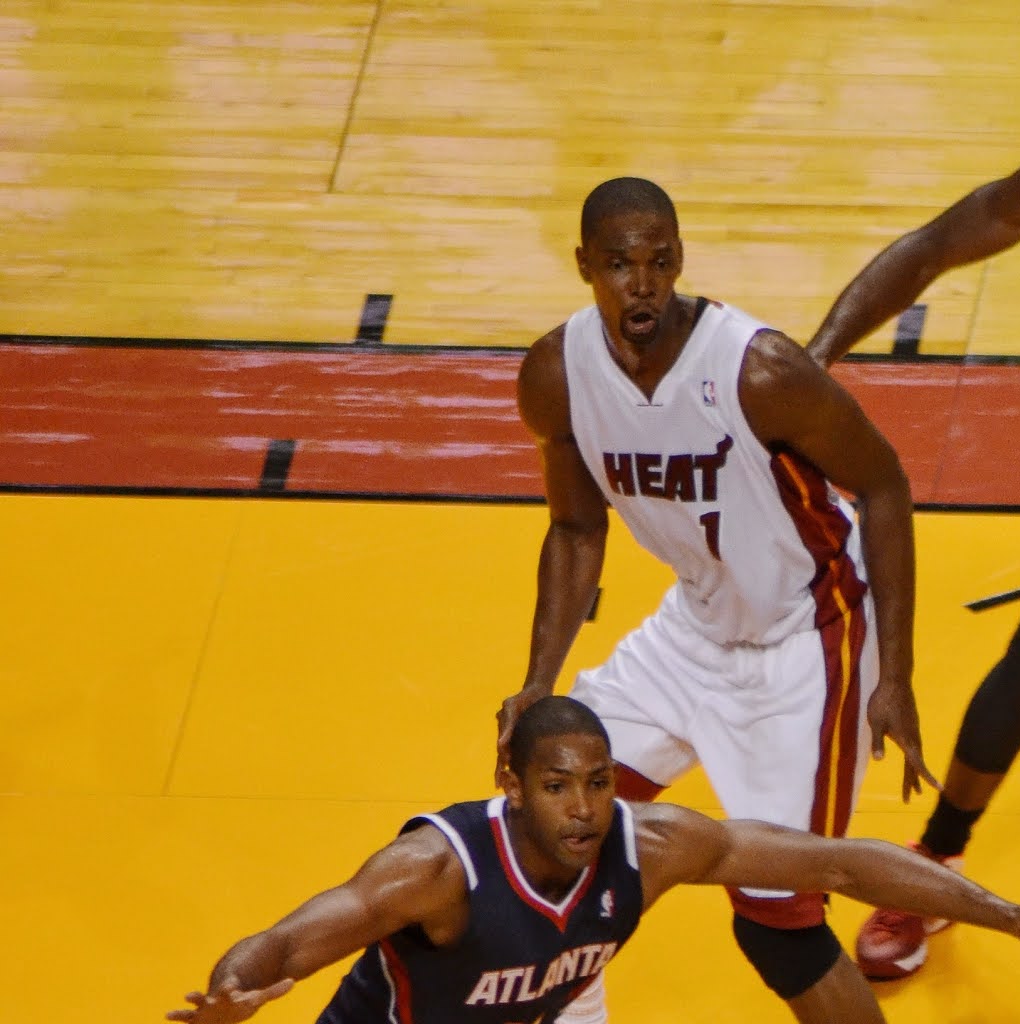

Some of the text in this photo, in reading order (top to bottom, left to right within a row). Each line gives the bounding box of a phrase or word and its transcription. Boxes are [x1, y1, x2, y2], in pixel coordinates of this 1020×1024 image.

[602, 433, 734, 503] HEAT
[699, 510, 722, 562] 1
[464, 941, 618, 1005] ATLANTA
